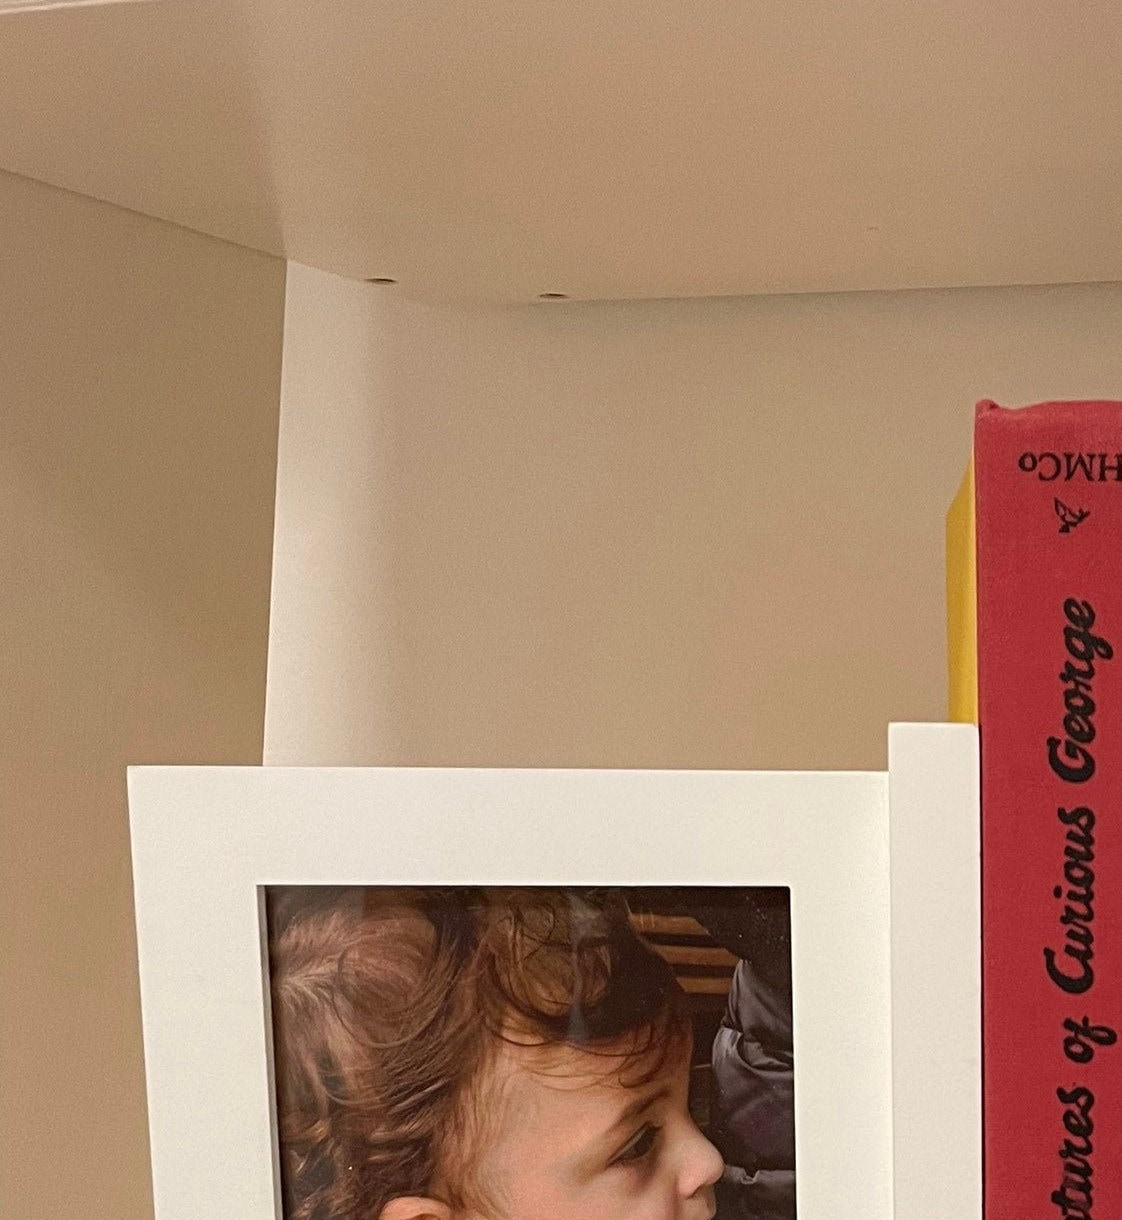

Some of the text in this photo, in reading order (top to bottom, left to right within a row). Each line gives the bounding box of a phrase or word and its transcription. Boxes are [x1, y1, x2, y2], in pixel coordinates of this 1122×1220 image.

[1046, 598, 1114, 785] George
[1042, 806, 1097, 996] Curious
[1062, 1015, 1118, 1066] of
